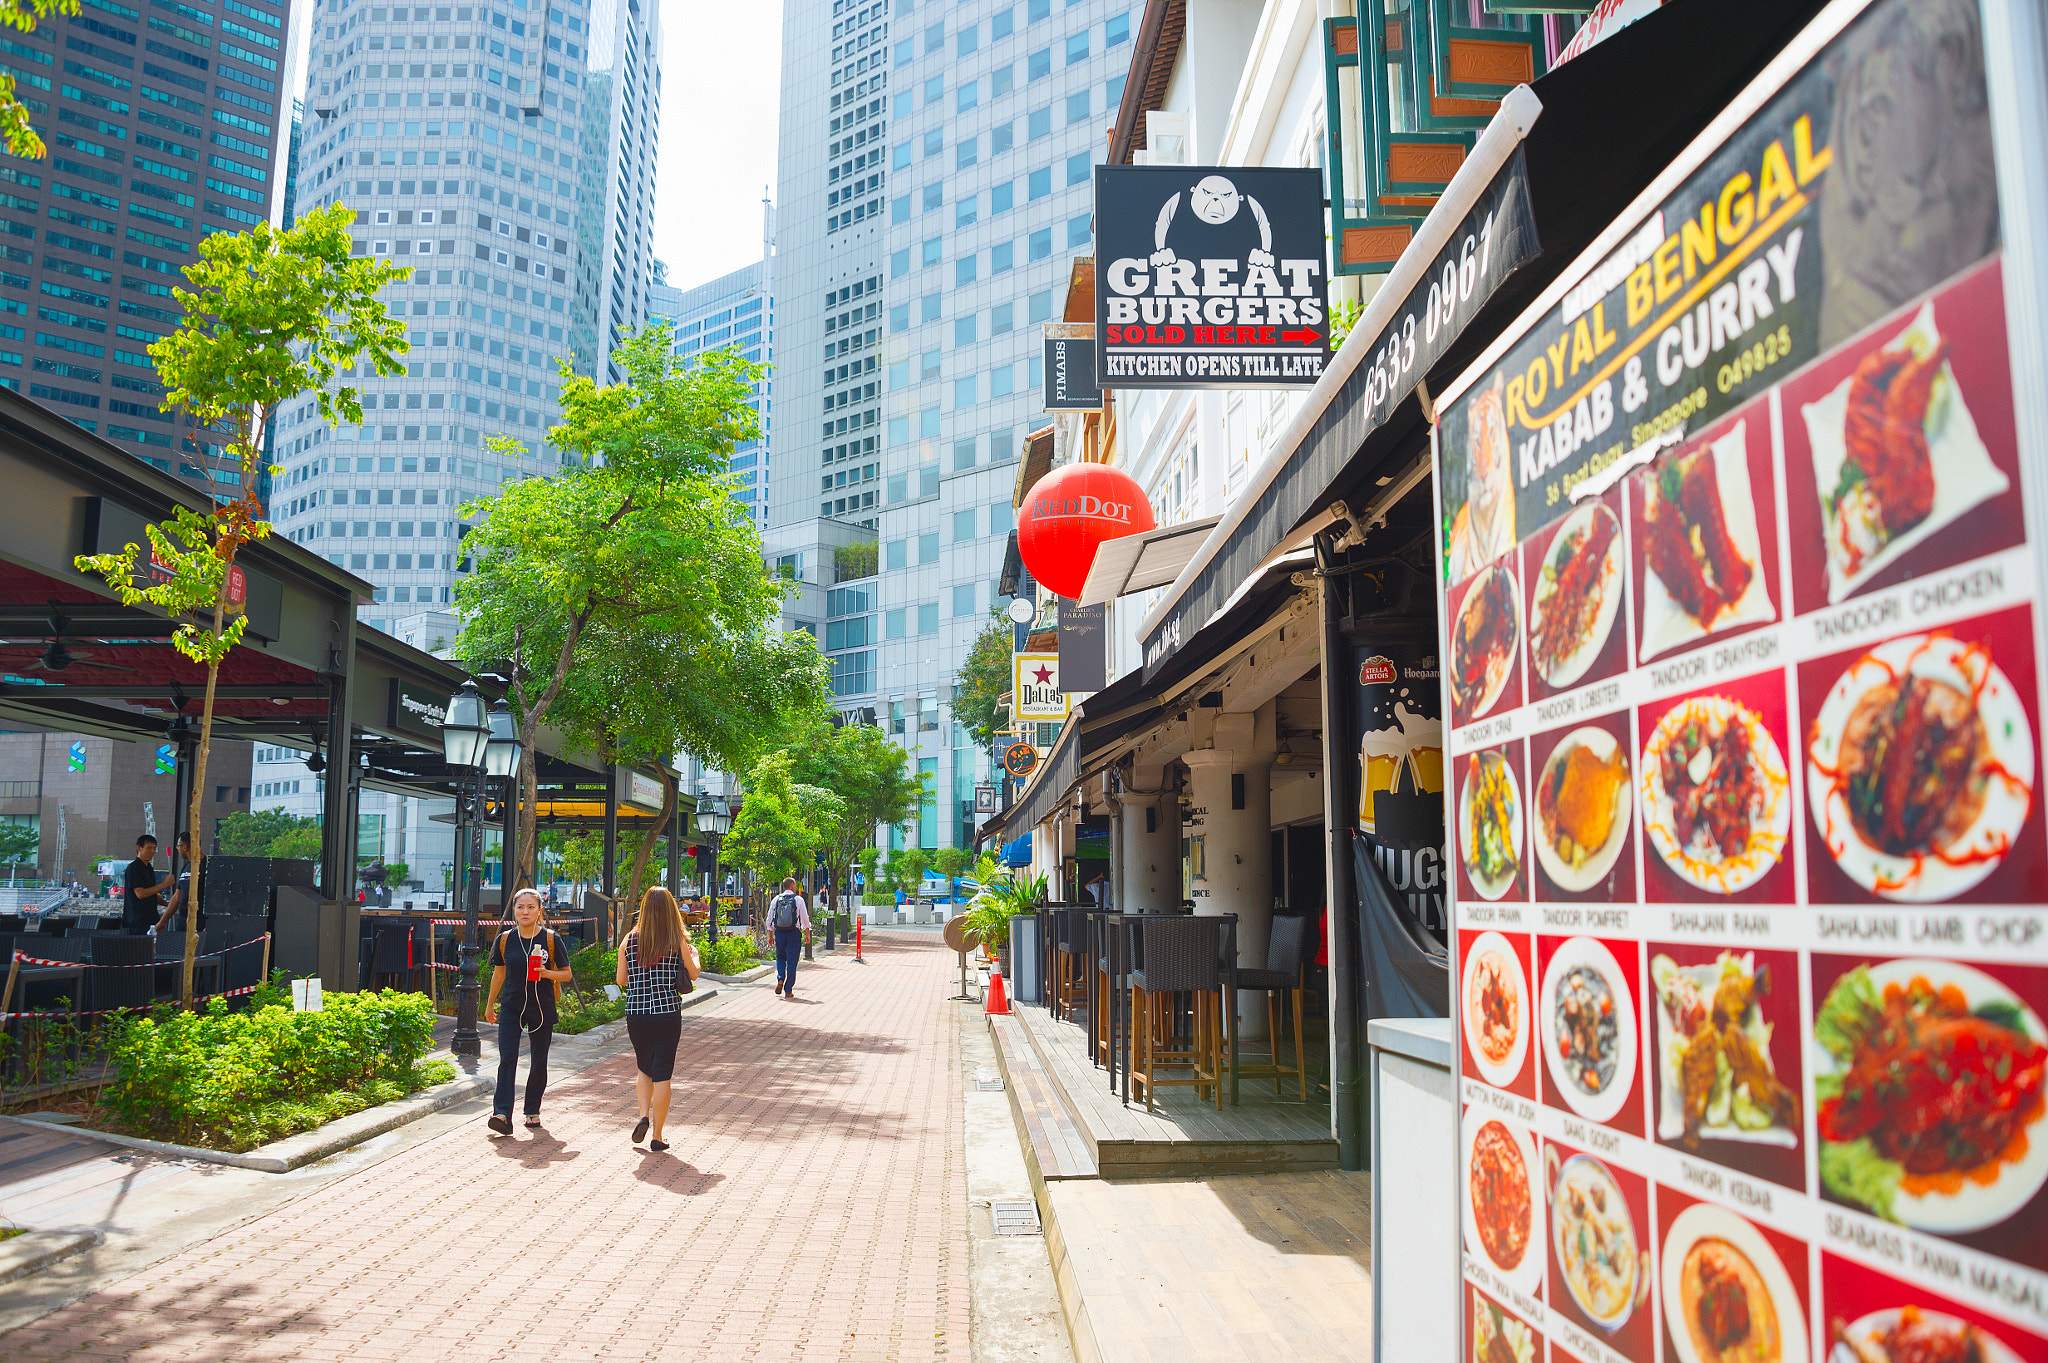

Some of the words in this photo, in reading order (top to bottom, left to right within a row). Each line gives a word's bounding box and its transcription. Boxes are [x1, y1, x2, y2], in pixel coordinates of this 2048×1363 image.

[1106, 257, 1320, 297] GREAT
[1506, 301, 1616, 429] ROYAL
[1625, 113, 1834, 329] BENGAL
[1106, 297, 1323, 325] BURGERS
[1106, 325, 1186, 344] SOLD
[1193, 326, 1276, 344] HERE
[1055, 341, 1067, 401] PIMABS
[1106, 355, 1183, 377] KITCHEN
[1185, 356, 1241, 377] OPENS
[1242, 356, 1279, 377] TILL
[1281, 356, 1323, 378] LATE
[1363, 313, 1416, 420] 6533
[1518, 379, 1615, 488] KABAB
[1621, 355, 1649, 414] &
[1656, 228, 1804, 387] CURRY
[1546, 481, 1560, 507] 36
[1631, 386, 1709, 450] Singapore
[230, 587, 242, 602] DOT
[232, 571, 243, 587] RED
[1813, 597, 1900, 643] TANDOORI
[1911, 568, 2003, 616] CHICKEN
[1365, 666, 1389, 674] STELLA
[1365, 672, 1389, 680] ARTOIS
[1651, 656, 1707, 690] TANDOORI
[1714, 632, 1779, 672] CRAYFISH
[401, 693, 427, 713] Singapore
[1537, 697, 1575, 724] TANDOORI
[1580, 682, 1621, 711] LOBSTER
[1586, 909, 1629, 929] POMFRET
[1671, 911, 1725, 934] SAHAJANI
[1733, 911, 1770, 935] RAAN
[1818, 914, 1899, 940] SAHAJANI
[1910, 915, 1964, 942] LAMB
[1977, 917, 2043, 945] CHOP
[1563, 1118, 1585, 1142] SAAG
[1589, 1127, 1621, 1156] GOSHT
[1680, 1160, 1723, 1195] TANGRI
[1730, 1180, 1773, 1214] KEBAB
[1826, 1212, 1904, 1263] SEABASS
